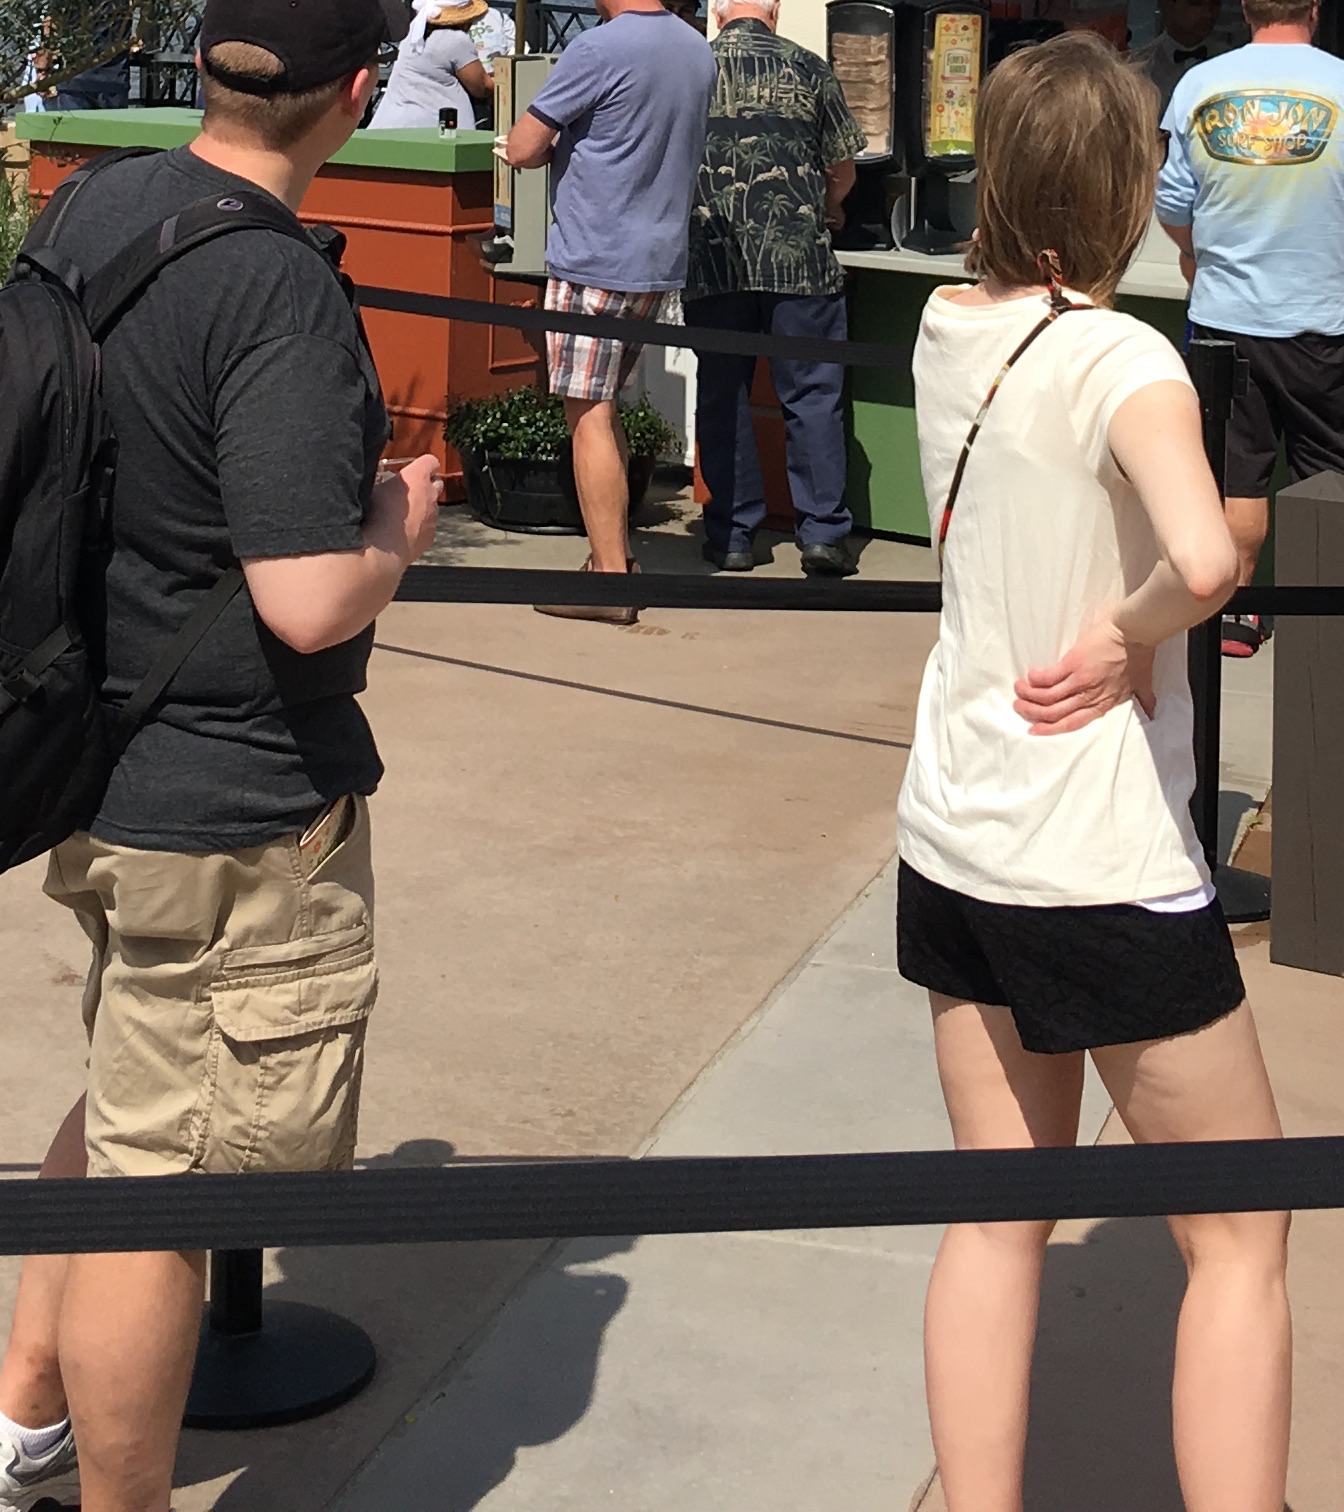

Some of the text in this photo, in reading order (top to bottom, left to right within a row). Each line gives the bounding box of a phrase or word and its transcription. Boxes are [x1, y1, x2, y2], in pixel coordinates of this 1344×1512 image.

[1204, 99, 1261, 134] RON
[1217, 133, 1308, 154] SURF SHOP
